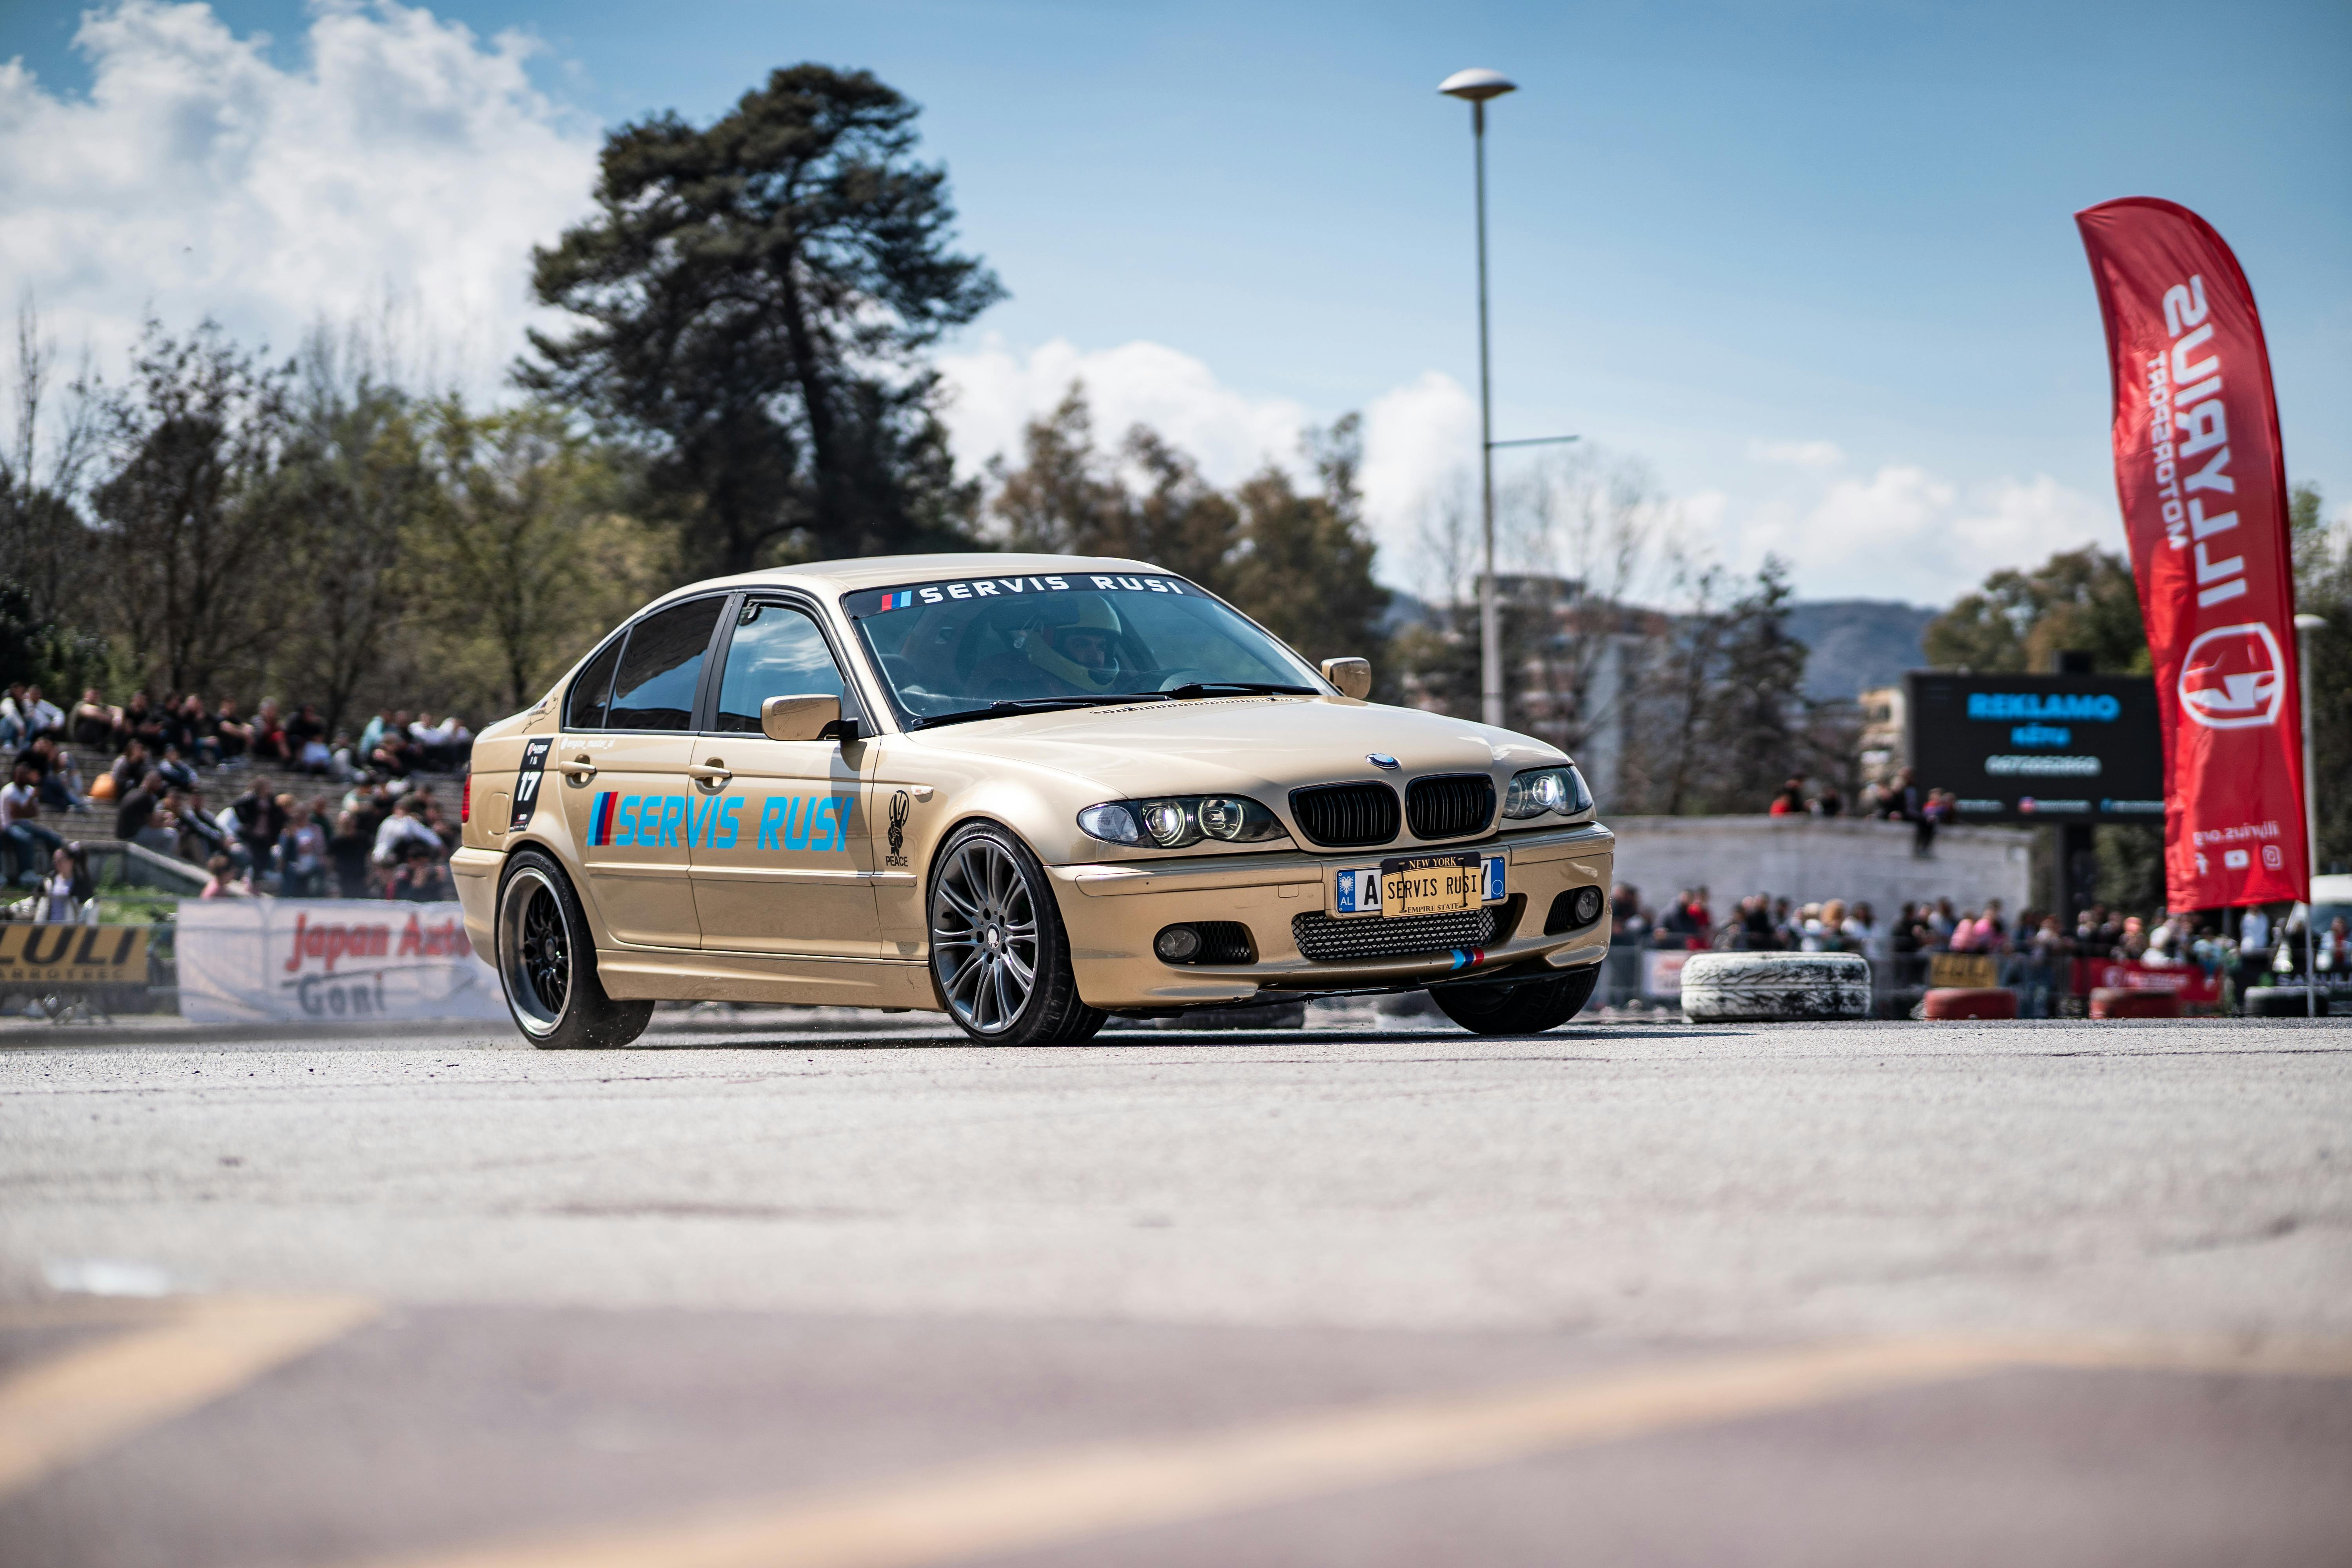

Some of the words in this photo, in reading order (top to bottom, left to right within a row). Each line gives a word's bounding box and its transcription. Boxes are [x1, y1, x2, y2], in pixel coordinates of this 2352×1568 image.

[919, 576, 1069, 604] SERVIS
[1090, 576, 1184, 594] RUSI
[517, 771, 541, 801] 17
[616, 795, 744, 849] SERVIS
[757, 796, 855, 852] RUSI
[886, 855, 908, 867] PEACE
[1409, 859, 1430, 870] NEW
[1432, 857, 1457, 867] YORK
[1388, 878, 1437, 900] SERVIS
[1446, 875, 1477, 895] RUSI
[1340, 897, 1353, 906] AL
[284, 911, 390, 972] Japan
